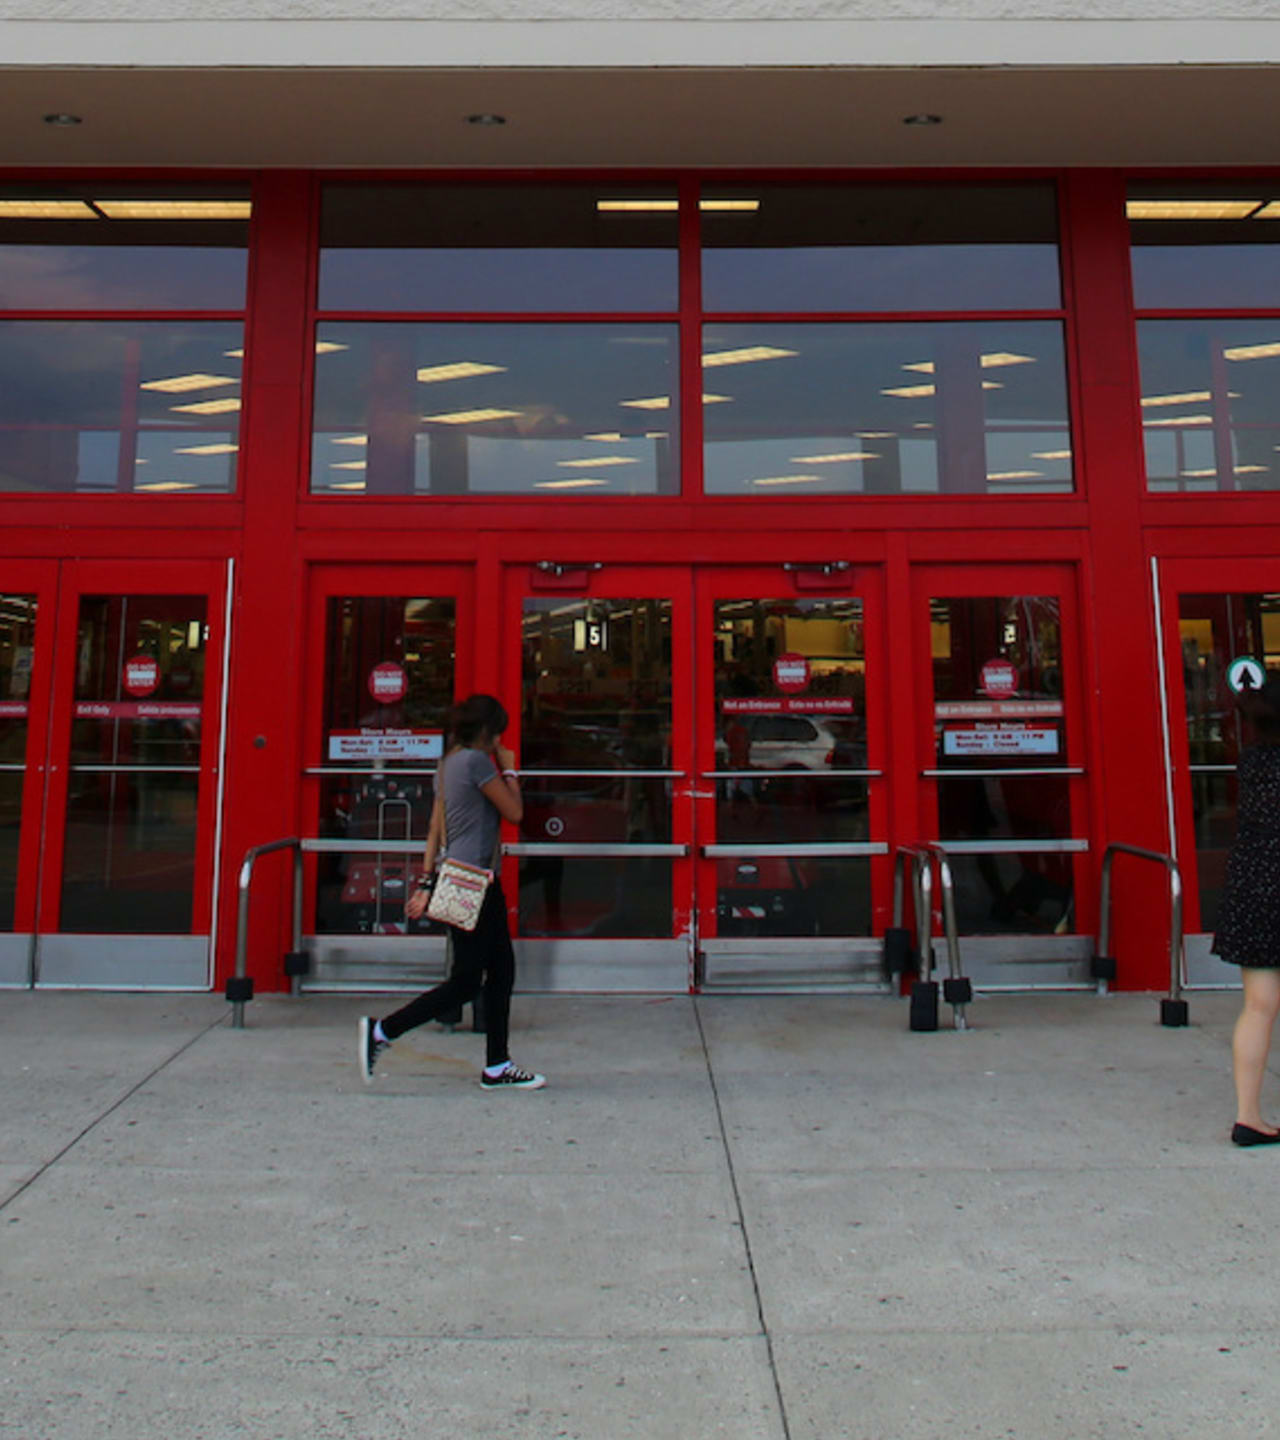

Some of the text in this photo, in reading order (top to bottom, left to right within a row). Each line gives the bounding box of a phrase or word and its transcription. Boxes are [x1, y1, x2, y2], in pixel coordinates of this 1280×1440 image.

[589, 625, 600, 646] 5
[140, 663, 157, 671] NOT
[387, 670, 403, 679] NOT
[128, 679, 155, 687] ENTER
[985, 682, 1012, 690] ENTER
[374, 685, 402, 694] ENTER
[749, 700, 781, 709] Entrance
[361, 727, 412, 735] Store Hours
